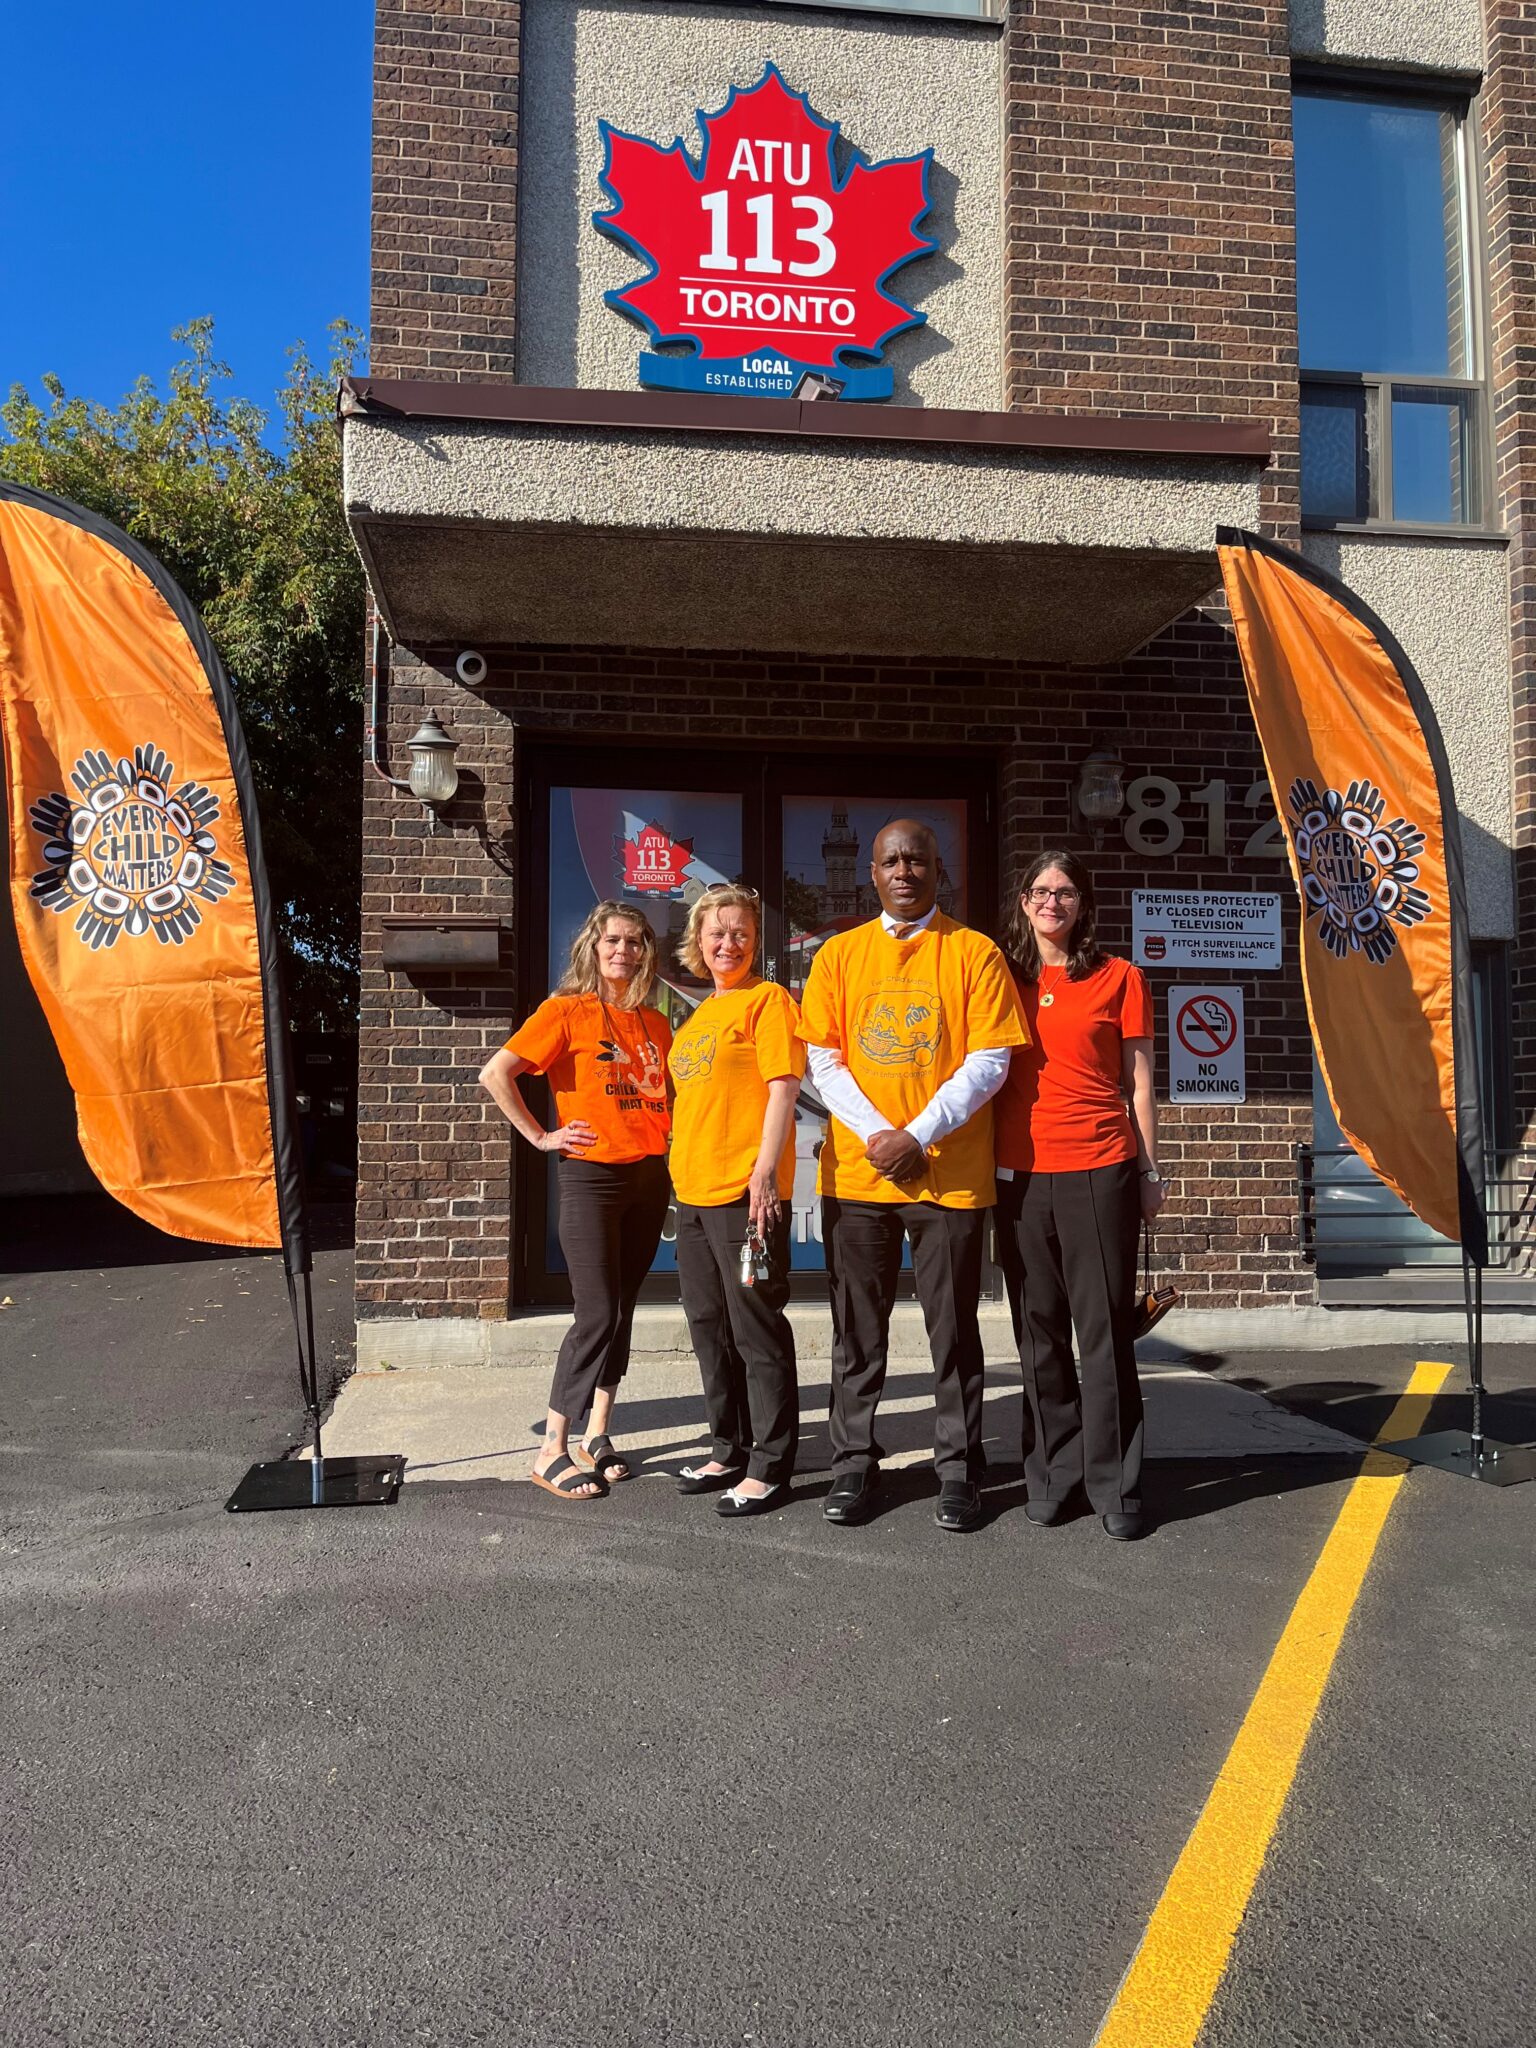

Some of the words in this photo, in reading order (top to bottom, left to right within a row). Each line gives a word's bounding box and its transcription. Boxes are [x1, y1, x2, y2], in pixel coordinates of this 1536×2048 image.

[727, 138, 811, 186] ATU
[699, 190, 836, 277] 113
[679, 288, 856, 326] TORONTO
[742, 358, 793, 375] LOCAL
[705, 373, 793, 391] ESTABLISHED
[102, 804, 169, 836] EVERY
[1123, 775, 1289, 857] 812
[92, 833, 181, 862] CHILD
[644, 836, 665, 848] ATU
[1314, 832, 1368, 859] EVERY
[637, 850, 671, 870] 113
[103, 859, 174, 892] MATTERS
[632, 873, 676, 882] TORONTO
[1316, 858, 1377, 883] CHILD
[1138, 894, 1200, 905] PREMISES
[1203, 896, 1275, 907] PROTECTED
[1327, 883, 1370, 911] MATTERS
[1145, 907, 1162, 917] BY
[1166, 907, 1215, 918] CLOSED
[1218, 908, 1267, 919] CIRCUIT
[1171, 919, 1243, 931] TELEVISION
[1172, 939, 1200, 949] FITCH
[1203, 940, 1275, 950] SURVEILLANCE
[1190, 950, 1235, 959] SYSTEMS
[1238, 951, 1258, 960] INC.
[1198, 1063, 1218, 1077] NO
[605, 1083, 639, 1096] CHILD
[1176, 1079, 1240, 1093] SMOKING
[619, 1099, 665, 1113] MATRS
